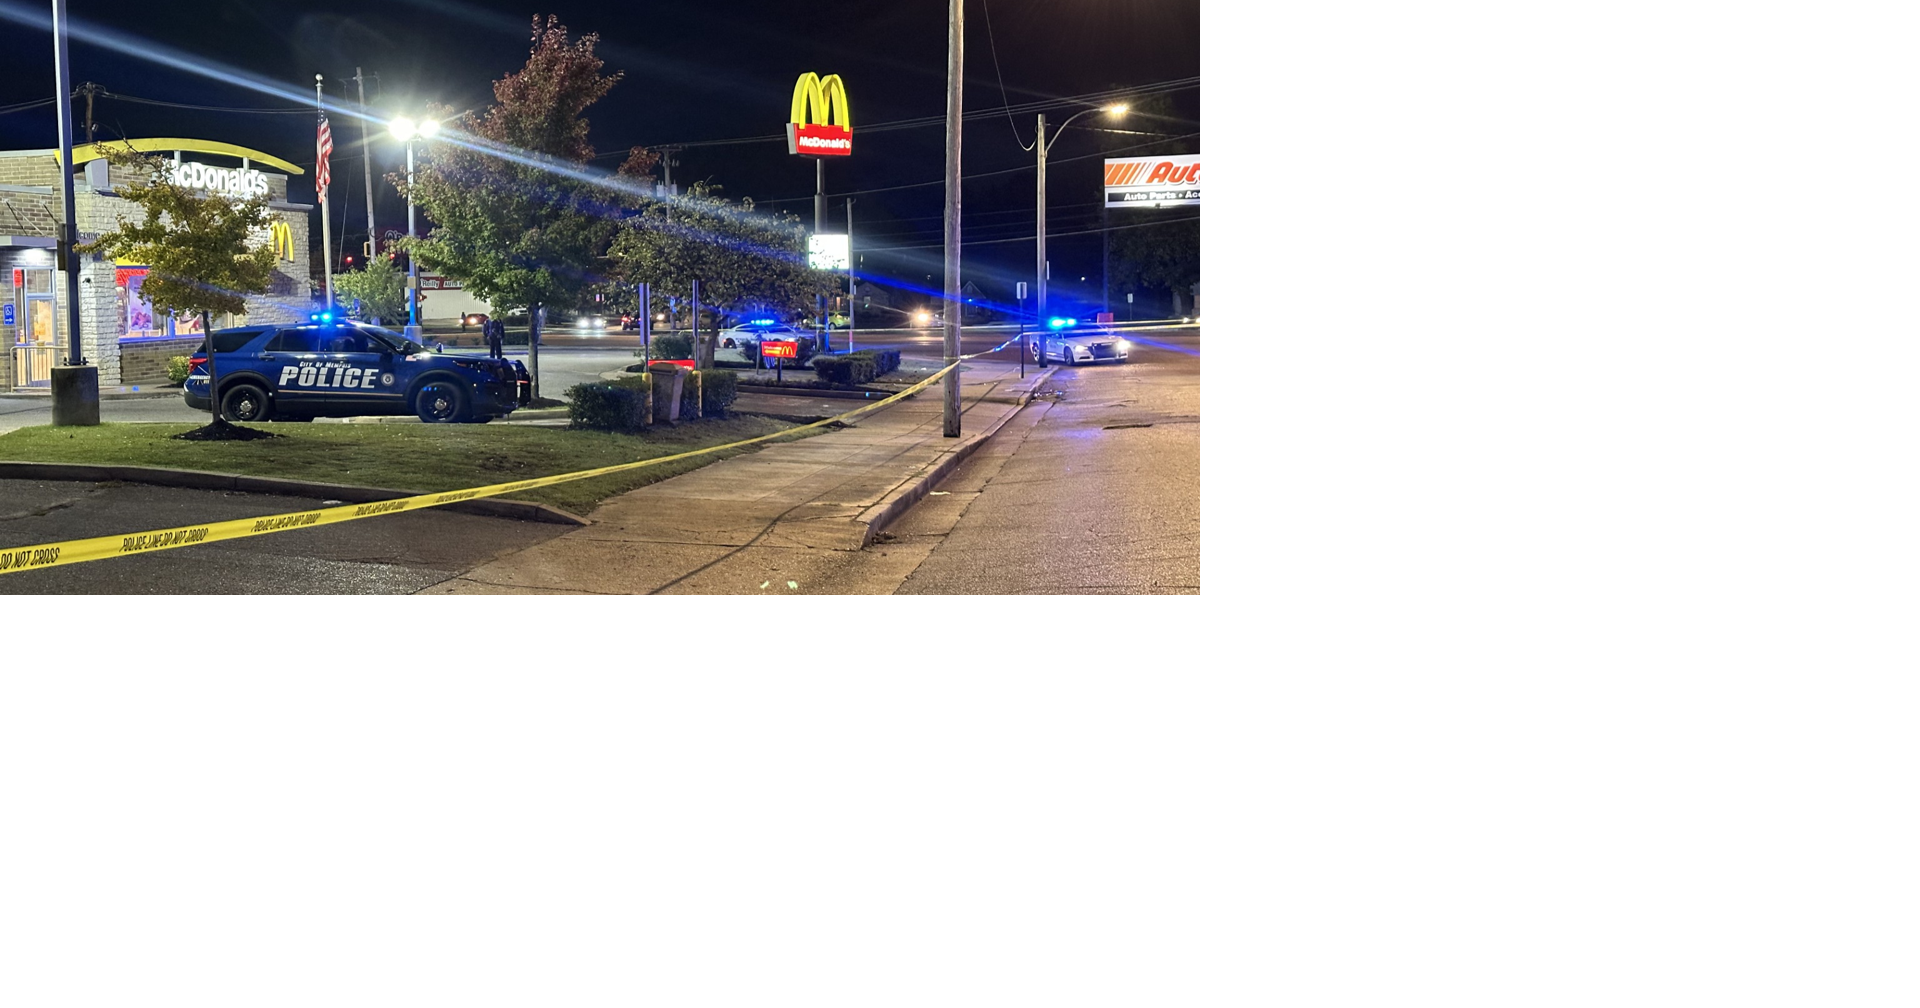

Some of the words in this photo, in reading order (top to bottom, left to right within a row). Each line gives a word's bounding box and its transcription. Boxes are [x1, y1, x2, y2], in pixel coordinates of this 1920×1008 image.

[799, 136, 851, 149] McDonald's
[1145, 161, 1200, 184] Aut
[1123, 193, 1148, 201] Auto
[1149, 191, 1177, 200] Parts
[76, 229, 100, 240] lcome
[279, 365, 379, 389] POLICE
[119, 535, 147, 552] POLICE
[144, 533, 163, 549] LINE
[170, 530, 187, 545] NOT
[0, 552, 12, 569] DO
[11, 550, 32, 569] NOT
[30, 547, 60, 566] CROSS
